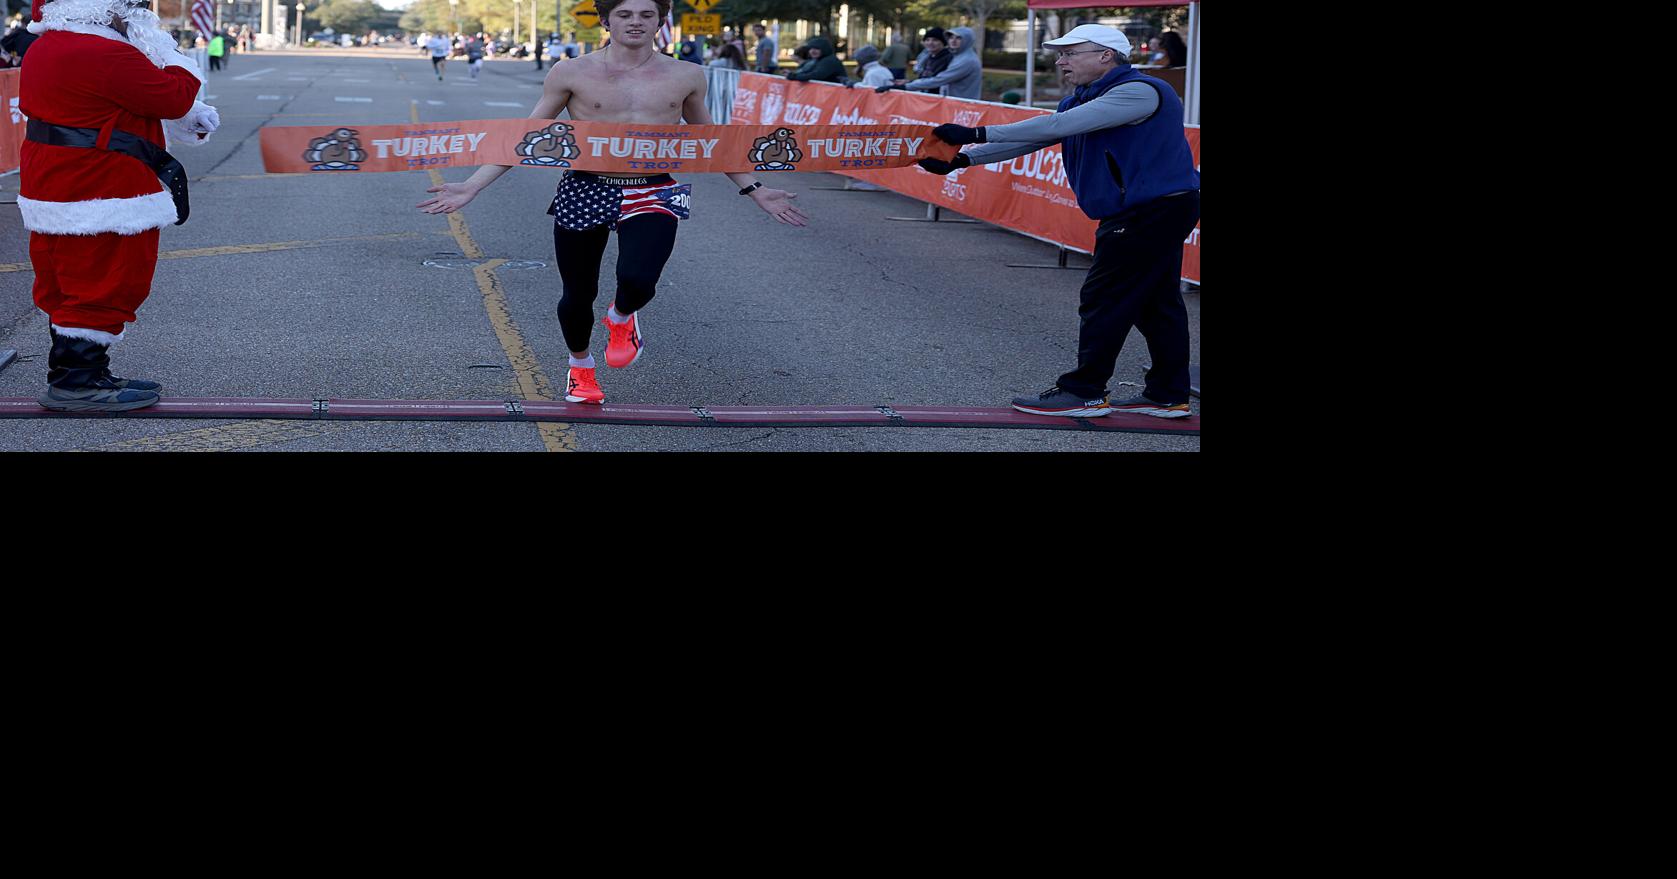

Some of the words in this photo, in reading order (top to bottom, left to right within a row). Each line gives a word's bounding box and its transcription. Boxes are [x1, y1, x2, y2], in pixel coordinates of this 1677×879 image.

[371, 132, 488, 159] TURKEY
[587, 137, 719, 159] TURKEY
[807, 137, 924, 158] TURKEY
[407, 156, 450, 167] TROT
[627, 161, 683, 169] TROT
[840, 159, 887, 167] TROT
